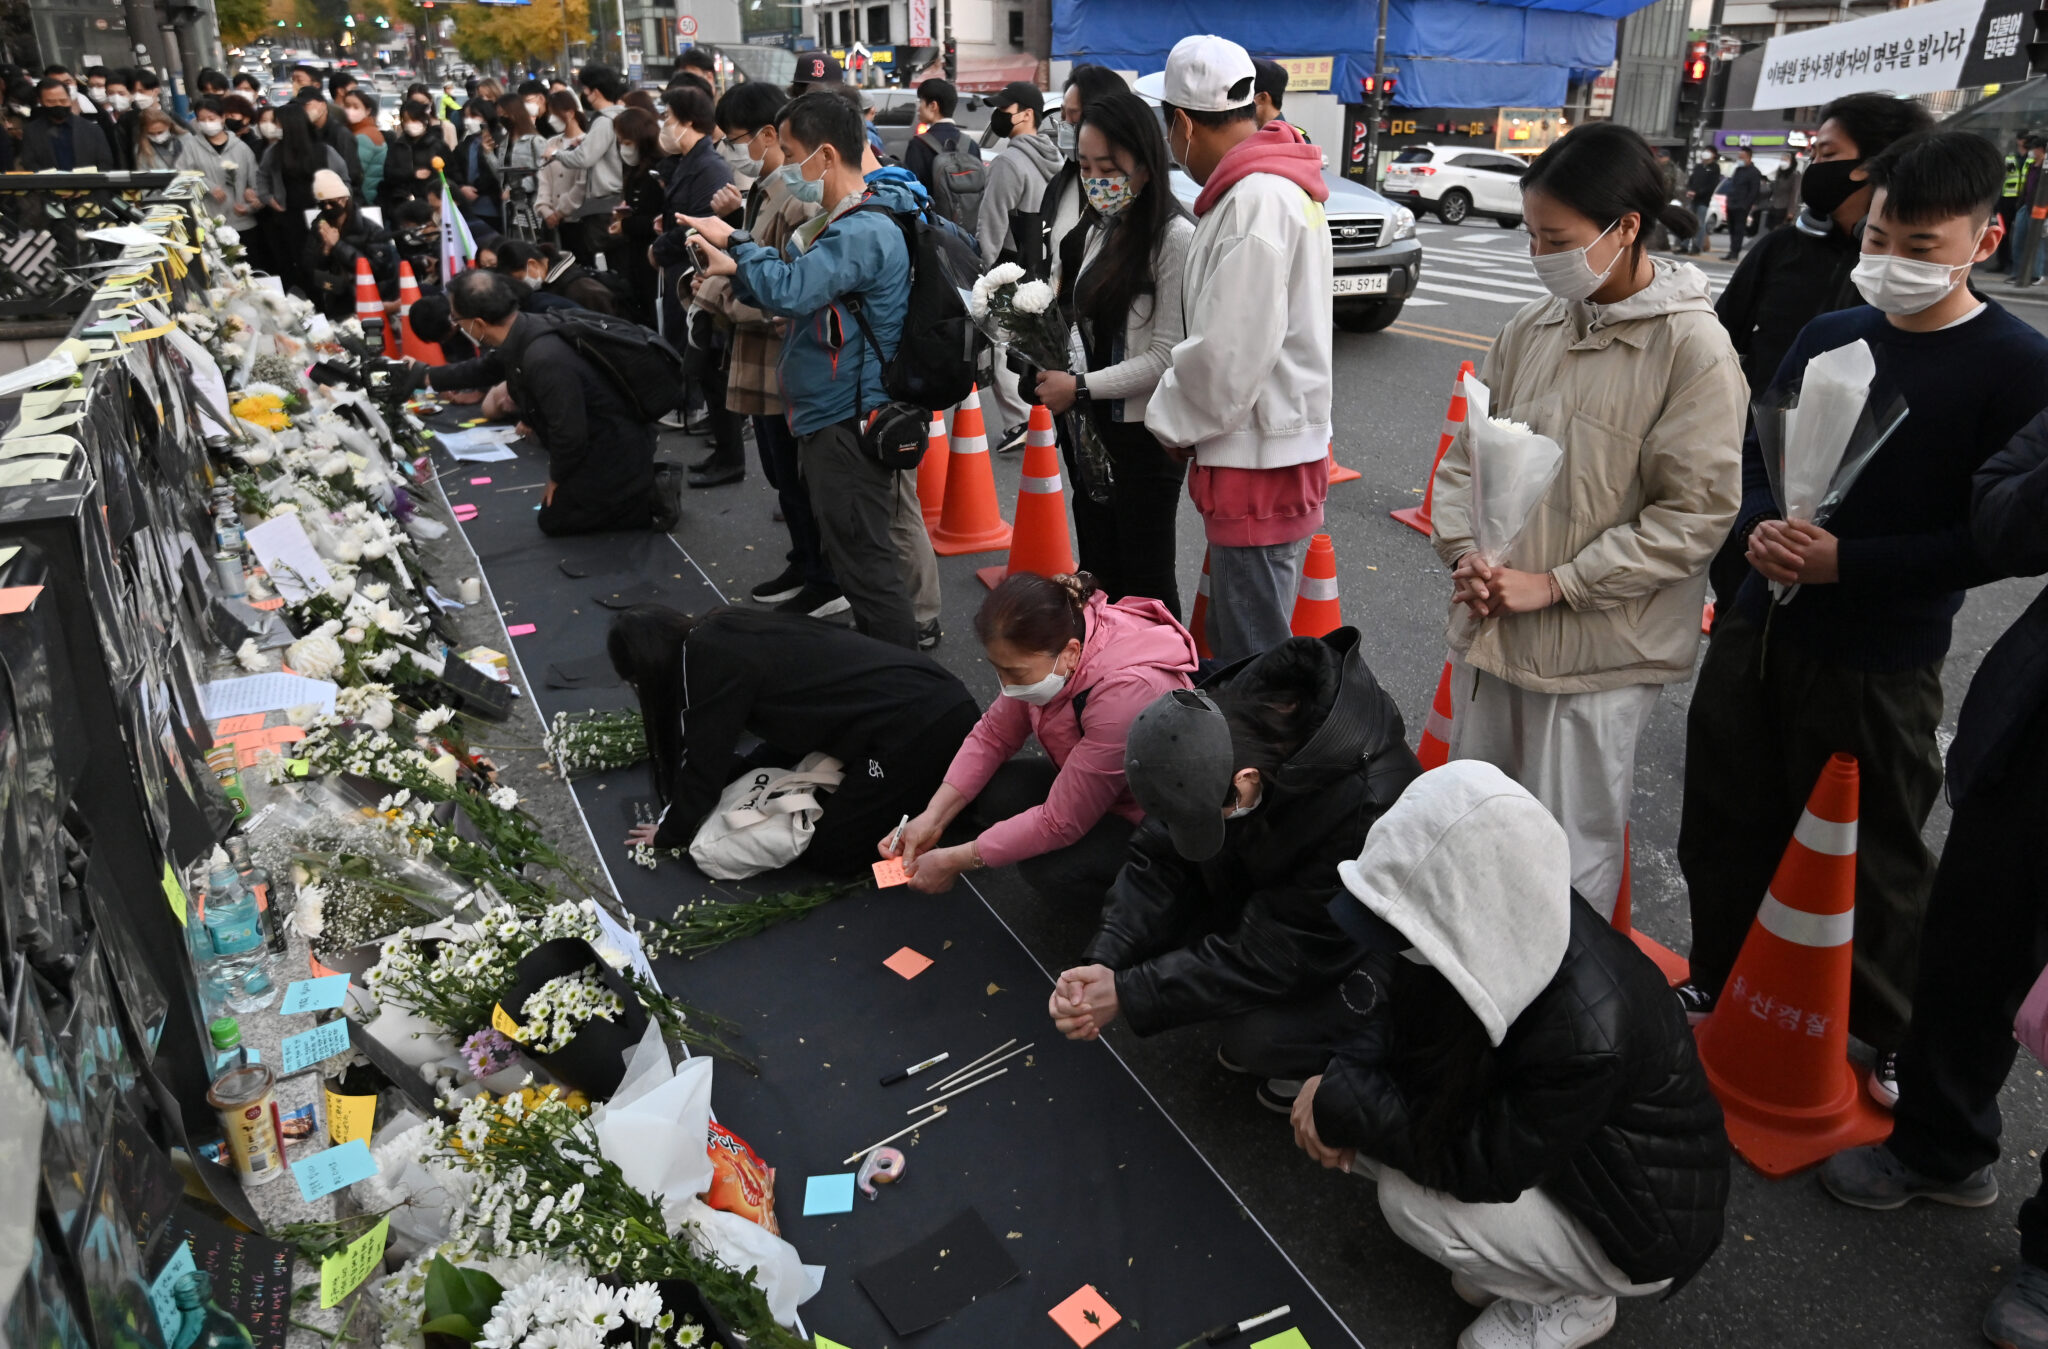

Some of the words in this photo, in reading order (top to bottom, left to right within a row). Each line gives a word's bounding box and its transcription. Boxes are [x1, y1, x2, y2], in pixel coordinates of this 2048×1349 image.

[682, 21, 694, 32] 50
[1987, 12, 2023, 38] 더불어
[1767, 58, 1798, 86] 이태원
[1873, 37, 1915, 73] 명복을
[1918, 28, 1966, 66] 빕니다
[1983, 34, 2020, 60] 민주당
[811, 59, 825, 78] B
[1357, 278, 1382, 291] 5914
